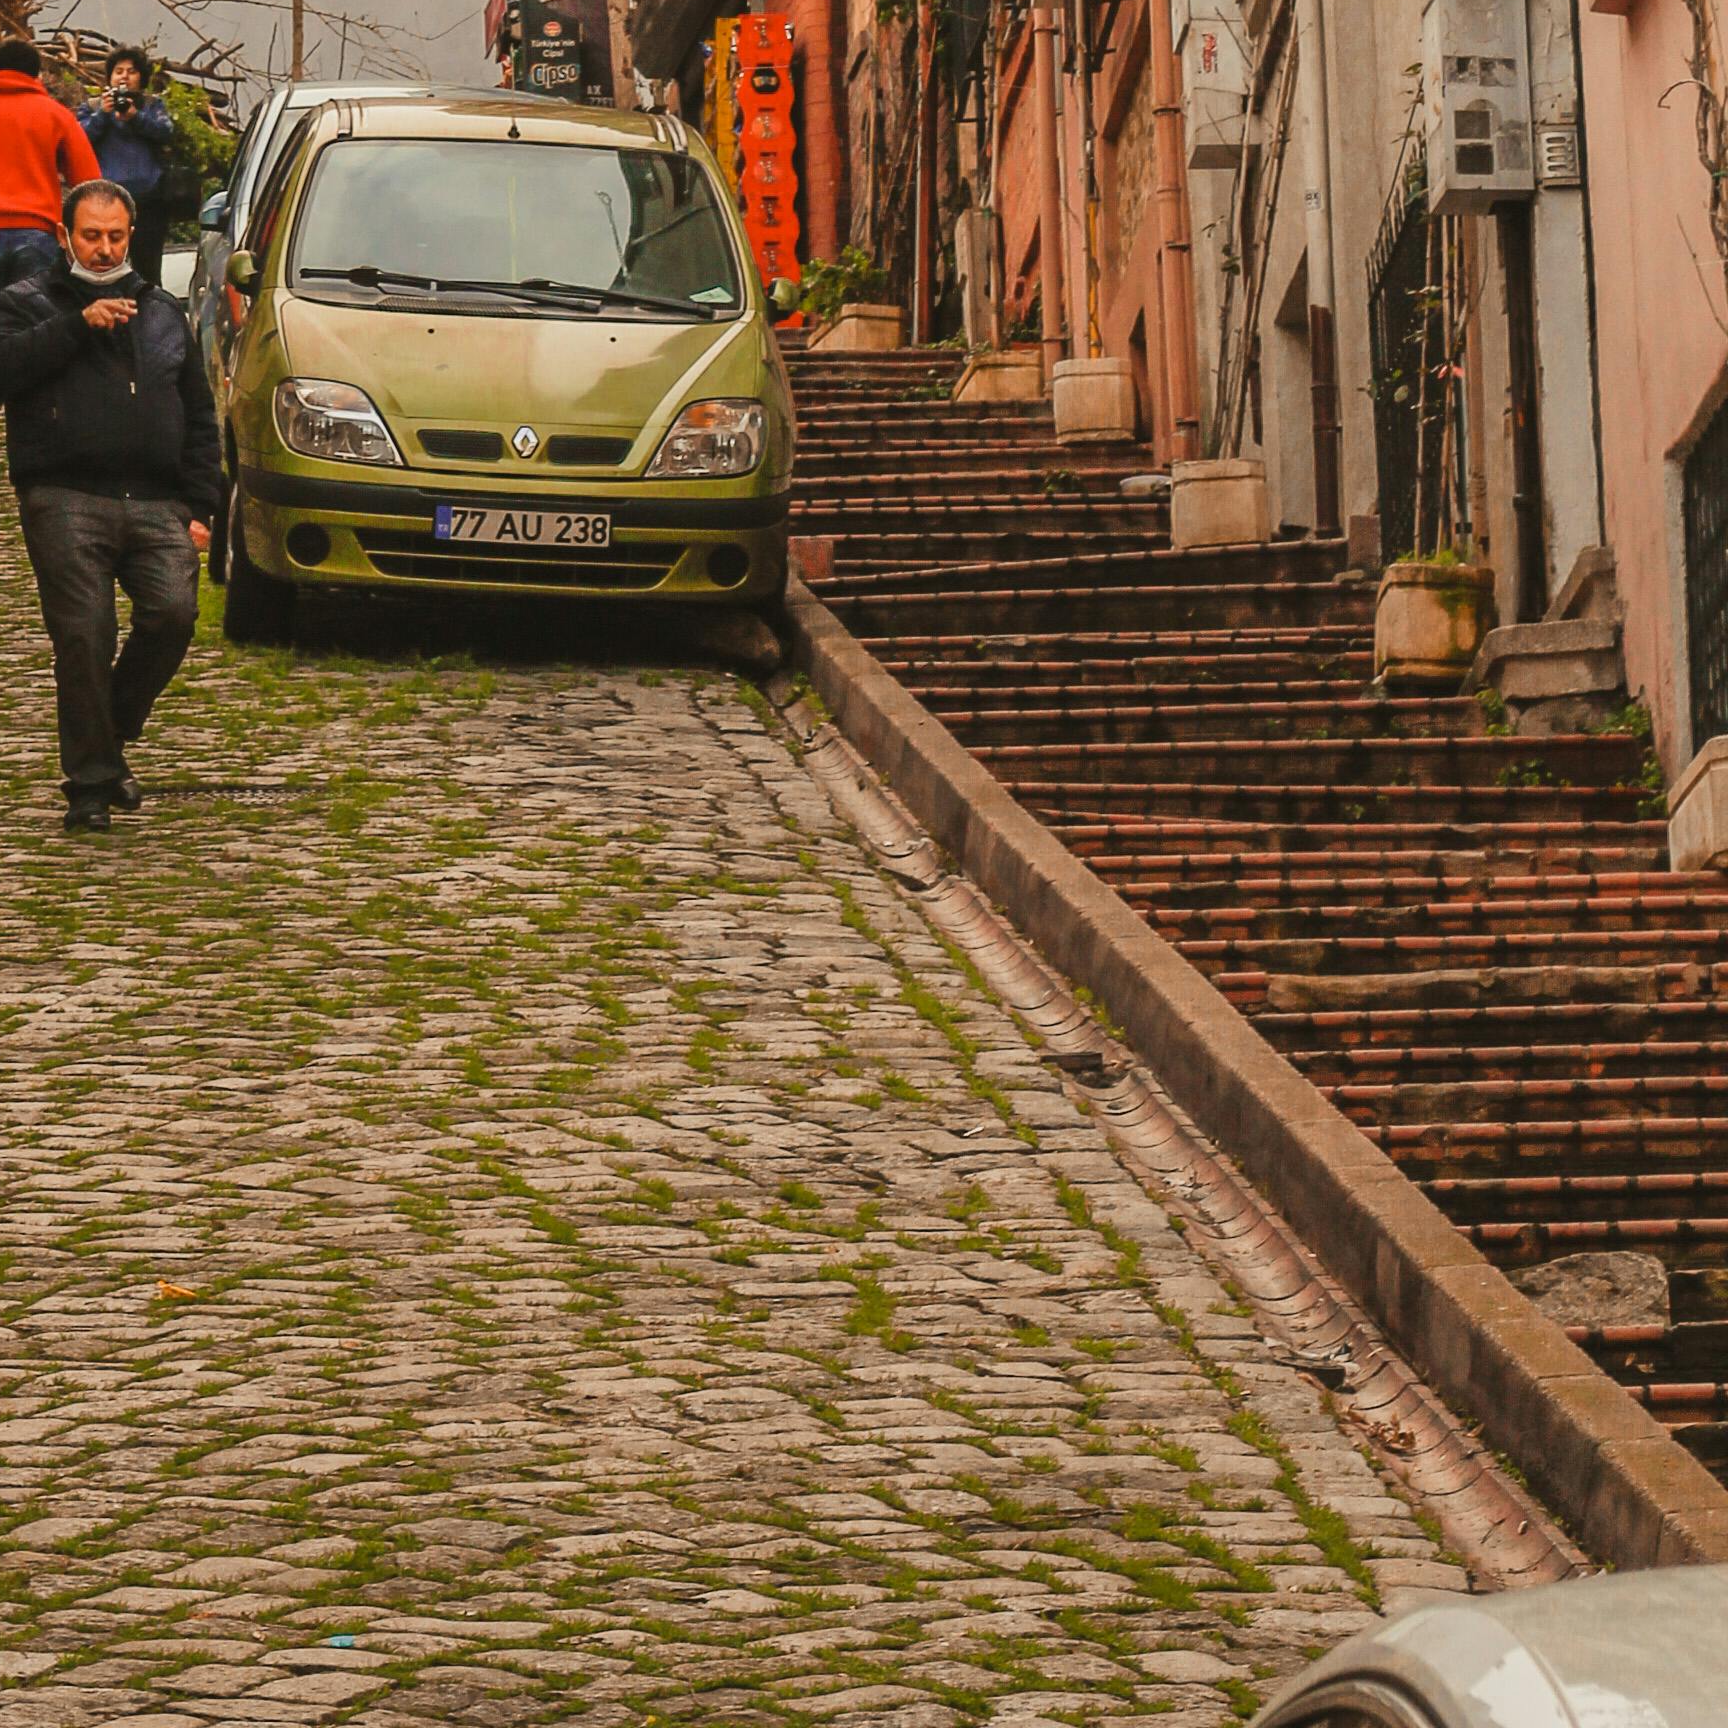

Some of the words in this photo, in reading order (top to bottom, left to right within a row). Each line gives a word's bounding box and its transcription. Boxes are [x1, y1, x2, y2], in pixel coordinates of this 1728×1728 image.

[451, 509, 487, 538] 77
[496, 513, 543, 541] AU
[554, 515, 608, 544] 238
